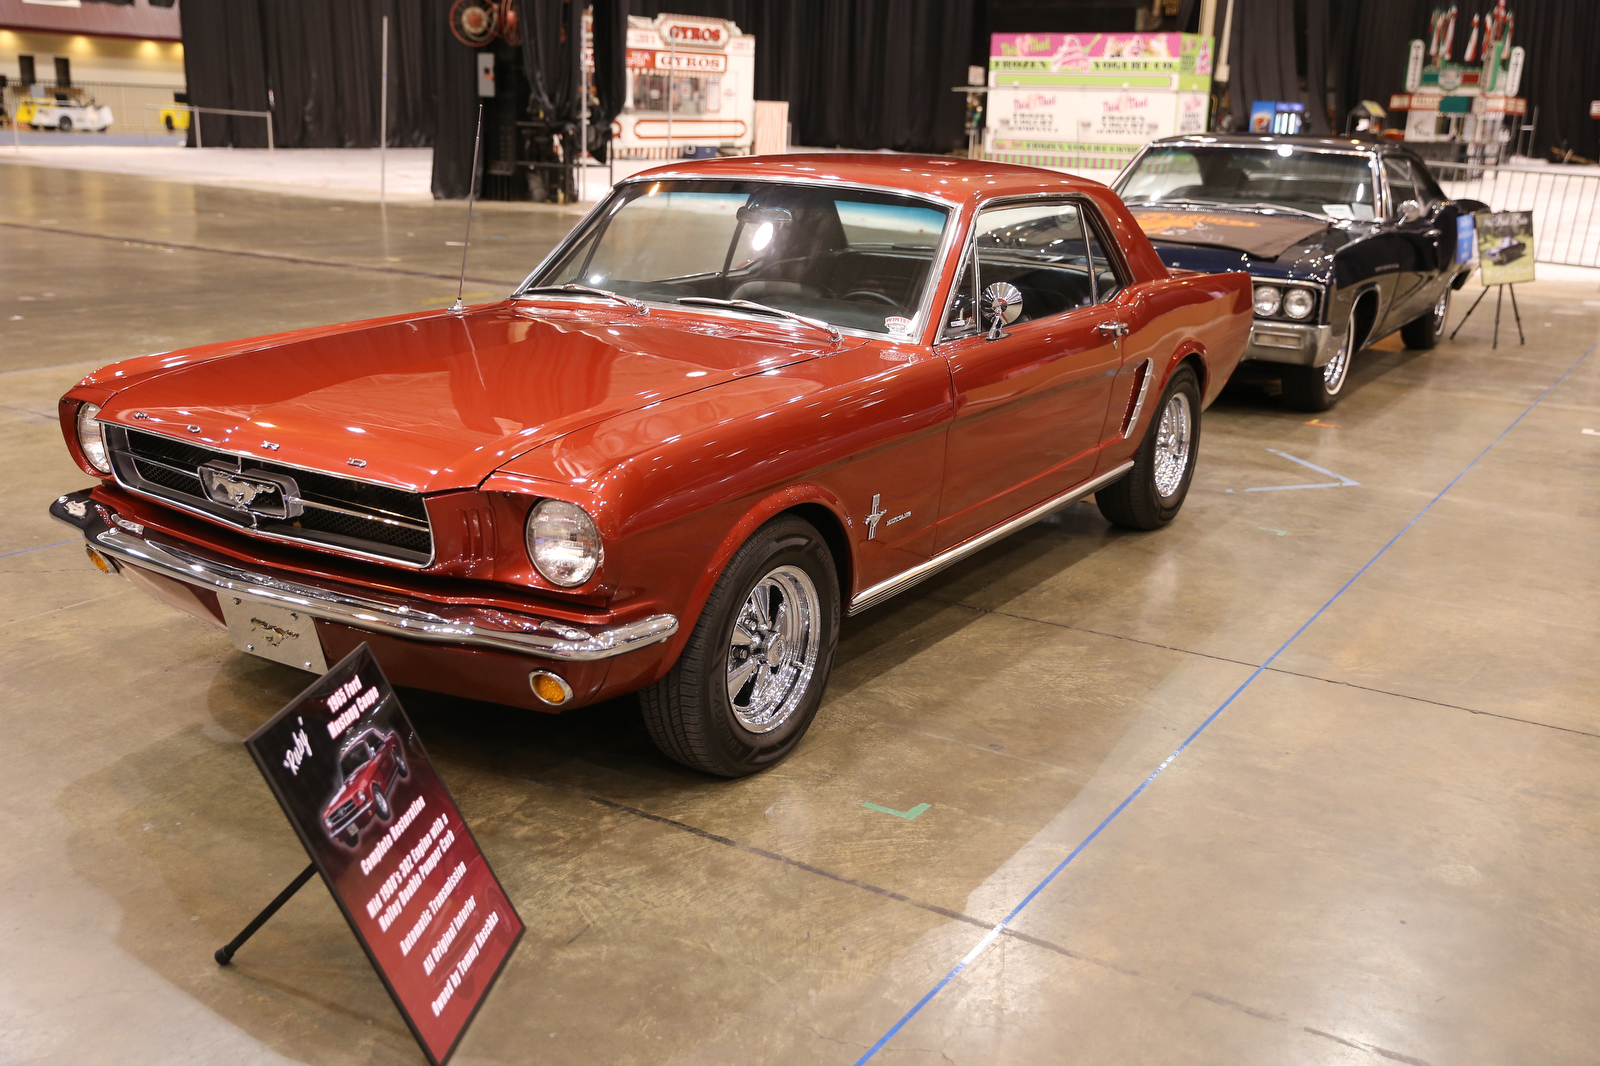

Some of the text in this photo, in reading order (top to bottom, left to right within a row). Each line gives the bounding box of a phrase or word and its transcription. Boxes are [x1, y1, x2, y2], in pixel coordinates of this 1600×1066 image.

[661, 55, 720, 68] GYROS
[669, 25, 721, 42] GYROS
[994, 60, 1048, 69] FROZEN
[1092, 61, 1149, 71] YOGURT
[326, 674, 363, 714] 1965 Ford
[326, 685, 380, 740] Mustang Coupe
[360, 795, 426, 876] Complete Restoration
[366, 893, 383, 920] Mid
[398, 854, 415, 879] 302
[410, 832, 433, 864] Engine
[430, 815, 446, 841] with
[441, 812, 449, 826] a
[377, 829, 455, 933] Holley Double Pumper Carb
[399, 860, 467, 957] Automatic Transmission
[422, 894, 477, 977] All Original Interior
[431, 978, 455, 1018] Owned
[449, 968, 462, 989] by
[456, 941, 480, 977] Tommy
